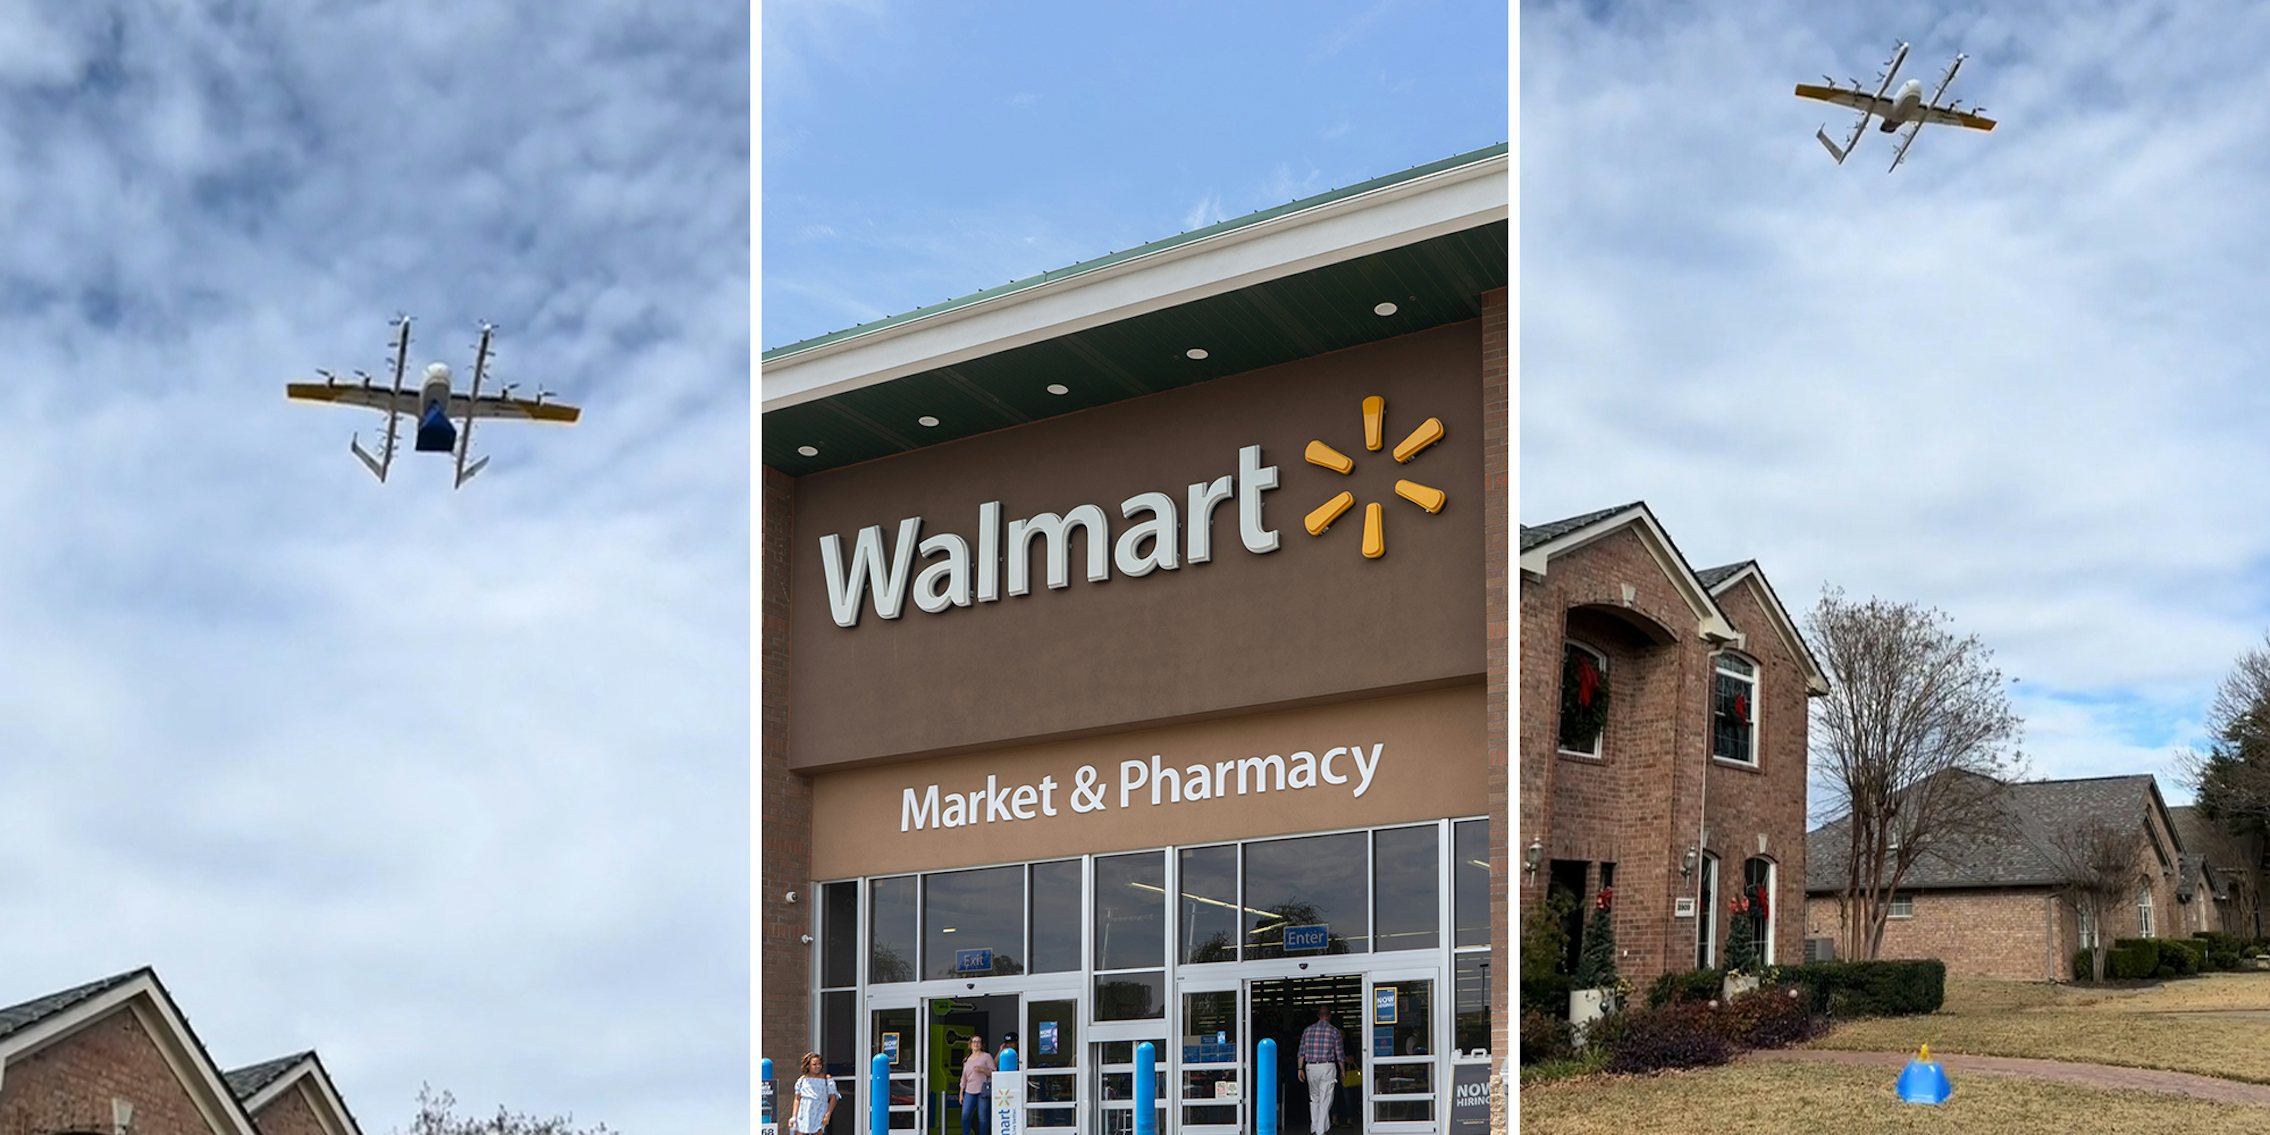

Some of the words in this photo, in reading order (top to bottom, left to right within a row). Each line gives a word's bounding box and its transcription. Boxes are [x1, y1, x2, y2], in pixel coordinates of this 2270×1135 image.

[818, 445, 1280, 627] Walmart
[900, 774, 1058, 832] Market
[1070, 765, 1107, 814] &
[1119, 743, 1384, 808] Pharmacy
[963, 953, 984, 967] Exit
[1288, 931, 1324, 945] Enter
